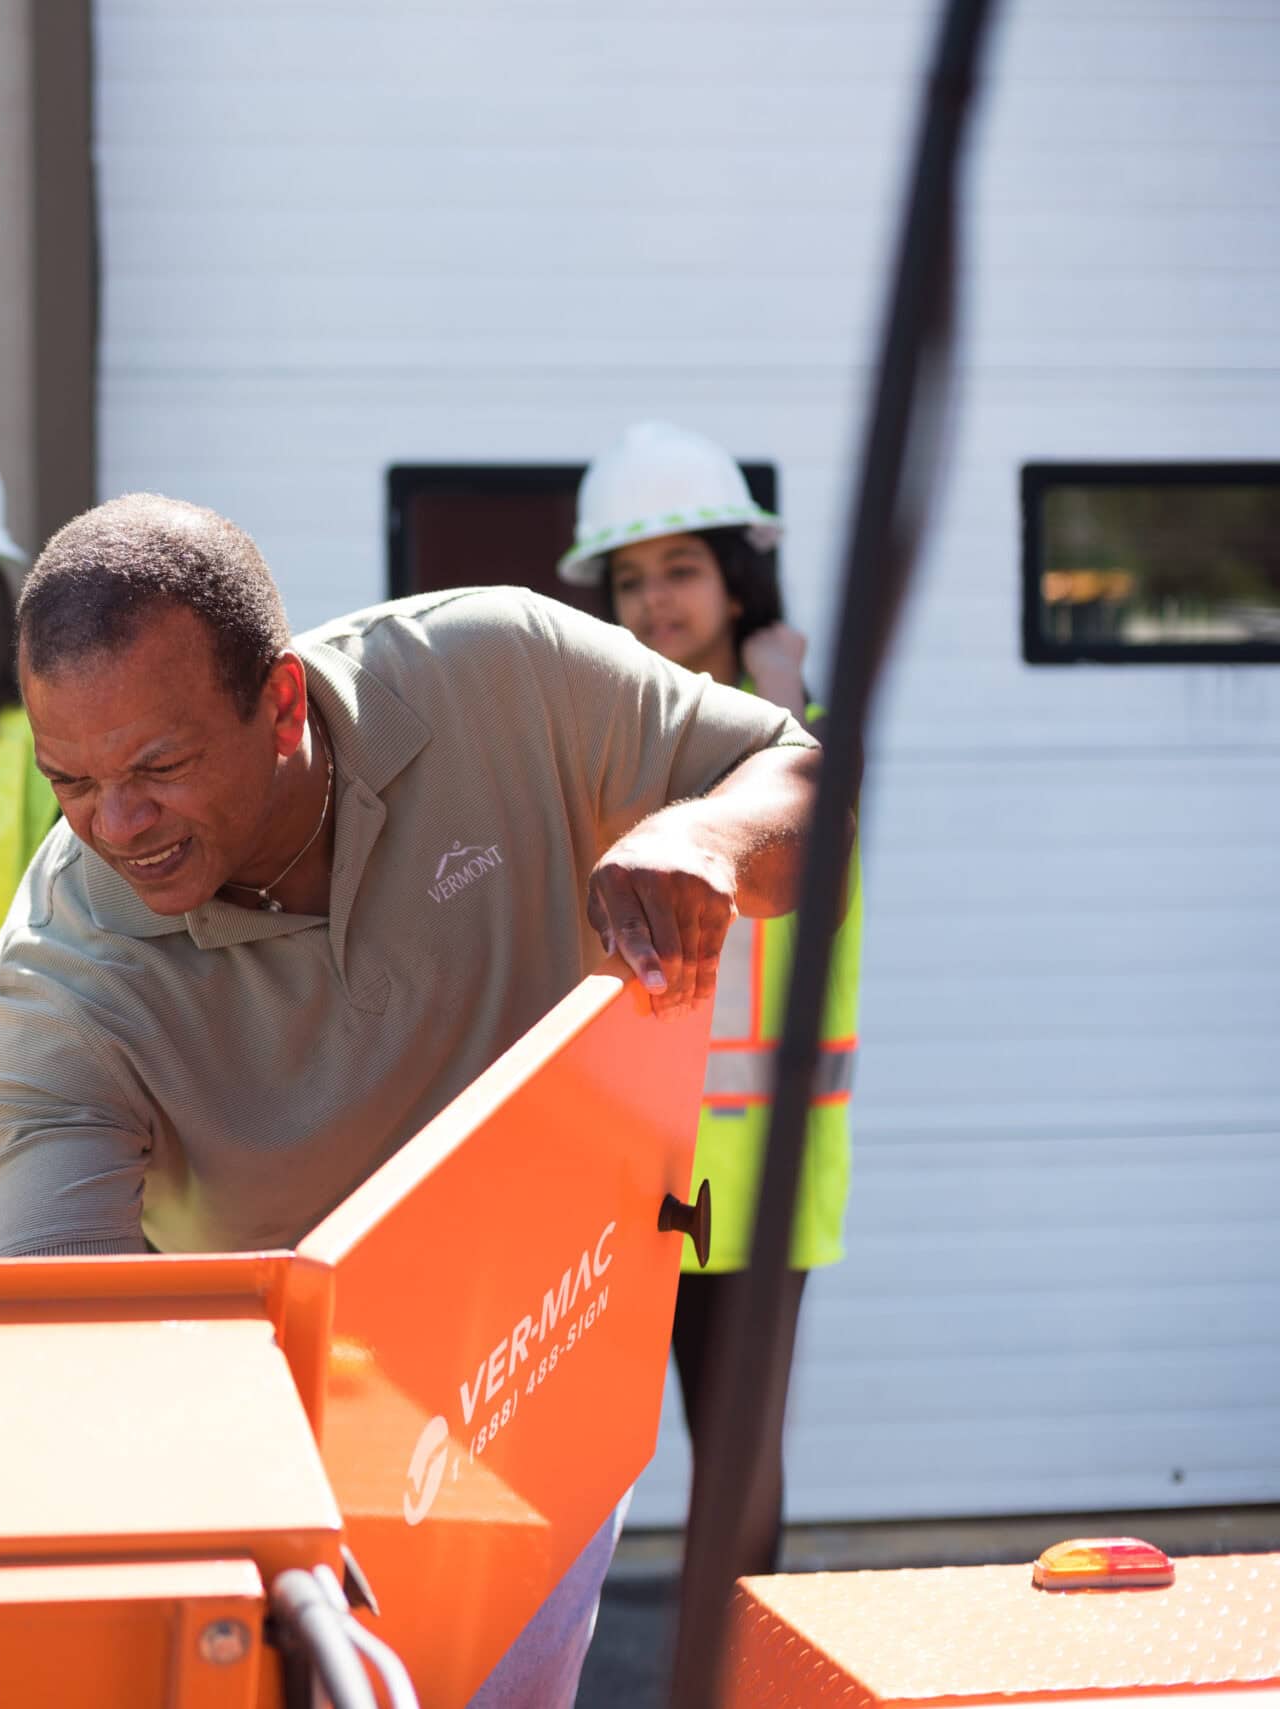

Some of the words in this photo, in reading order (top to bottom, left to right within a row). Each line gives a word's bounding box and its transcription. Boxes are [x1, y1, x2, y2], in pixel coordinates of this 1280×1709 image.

[427, 844, 503, 903] VERMONT
[459, 1221, 617, 1425] VER-MAC
[469, 1388, 518, 1465] (888)
[526, 1285, 609, 1395] 488-SIGN
